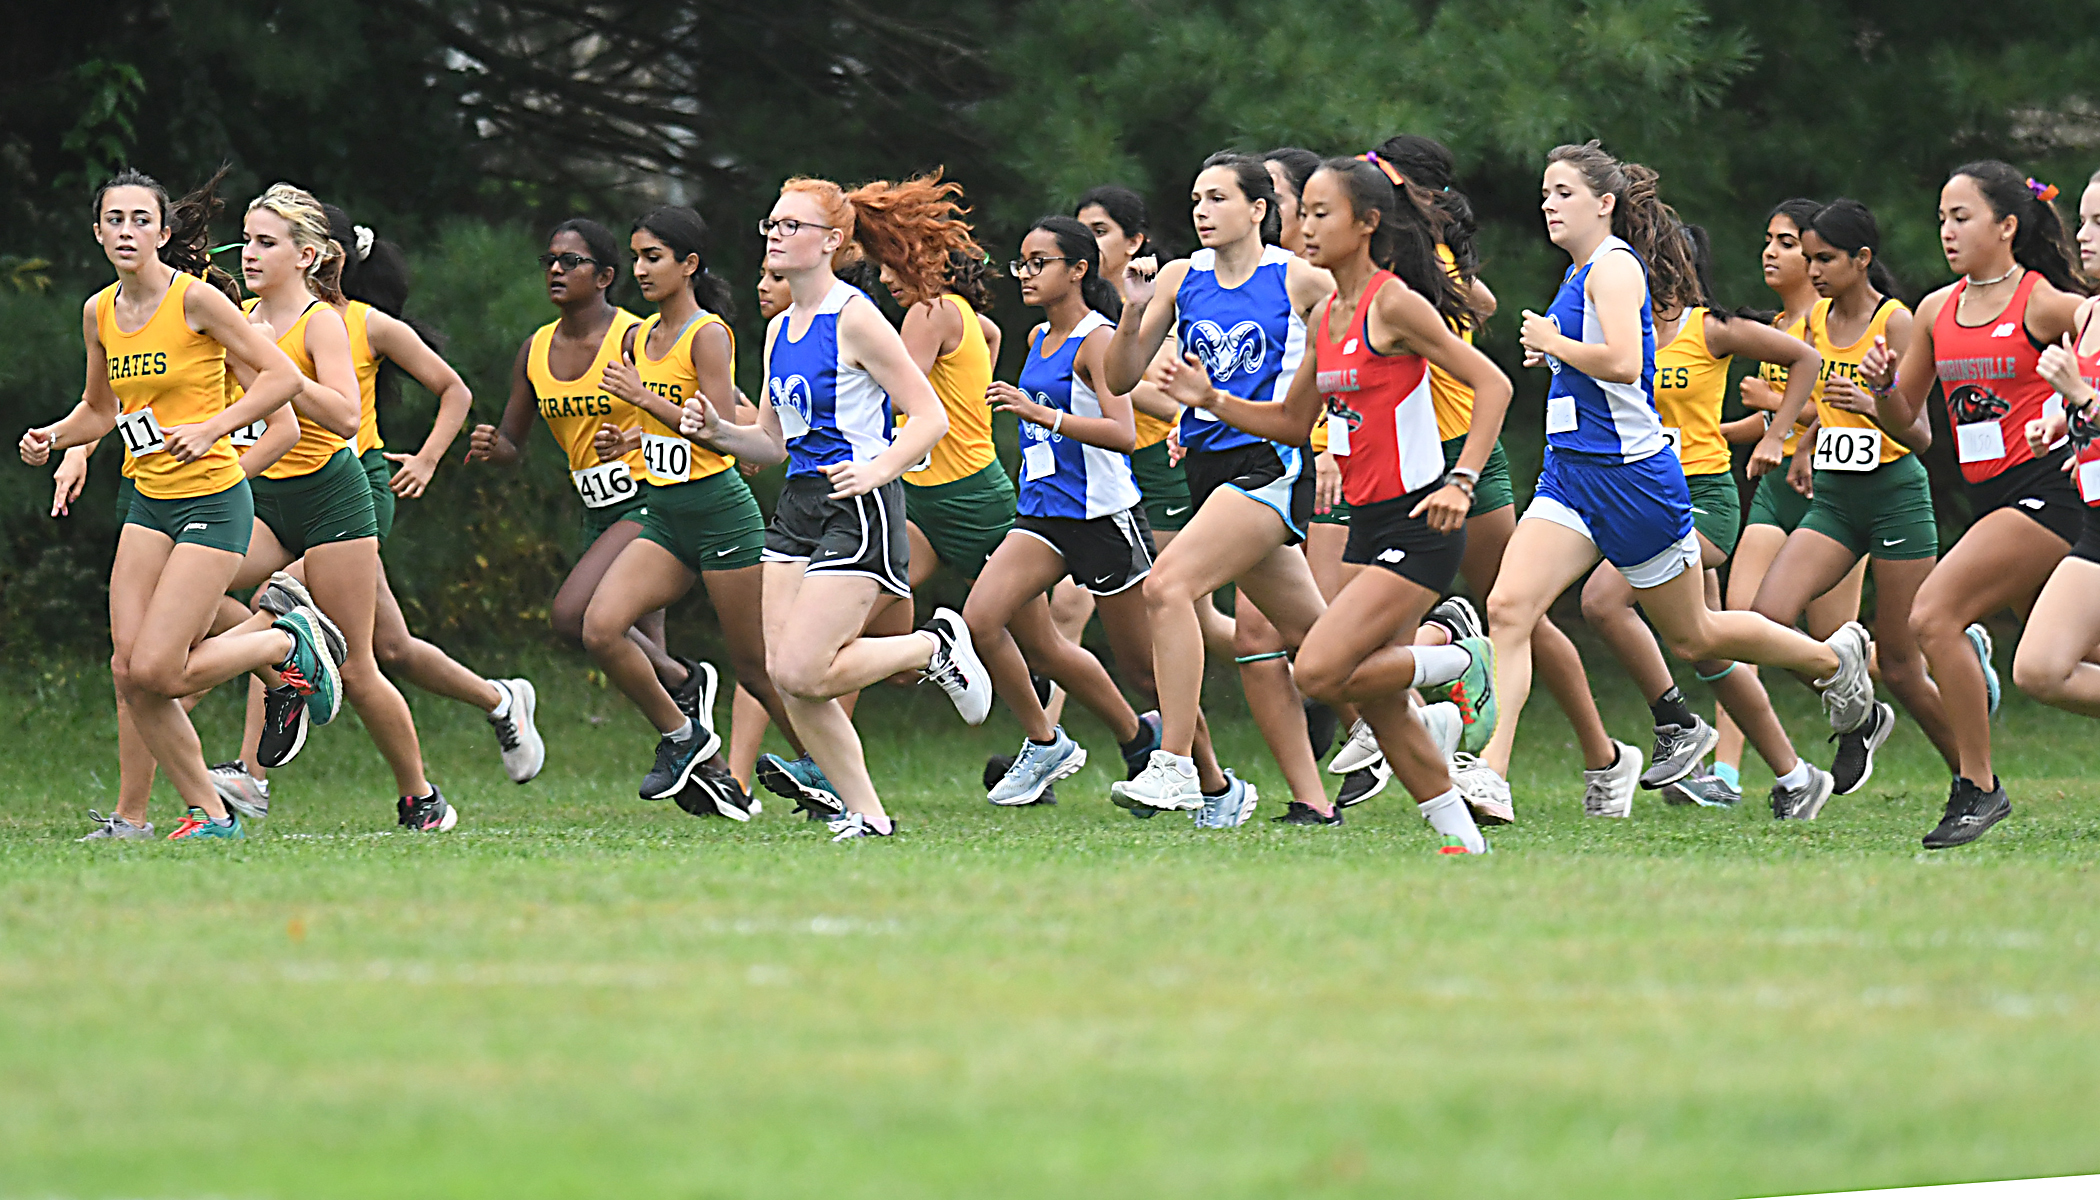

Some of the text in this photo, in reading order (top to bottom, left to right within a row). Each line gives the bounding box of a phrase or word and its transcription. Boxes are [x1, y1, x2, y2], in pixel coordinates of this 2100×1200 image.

[643, 440, 687, 475] 410
[1817, 433, 1875, 465] 403
[581, 467, 632, 502] 416
